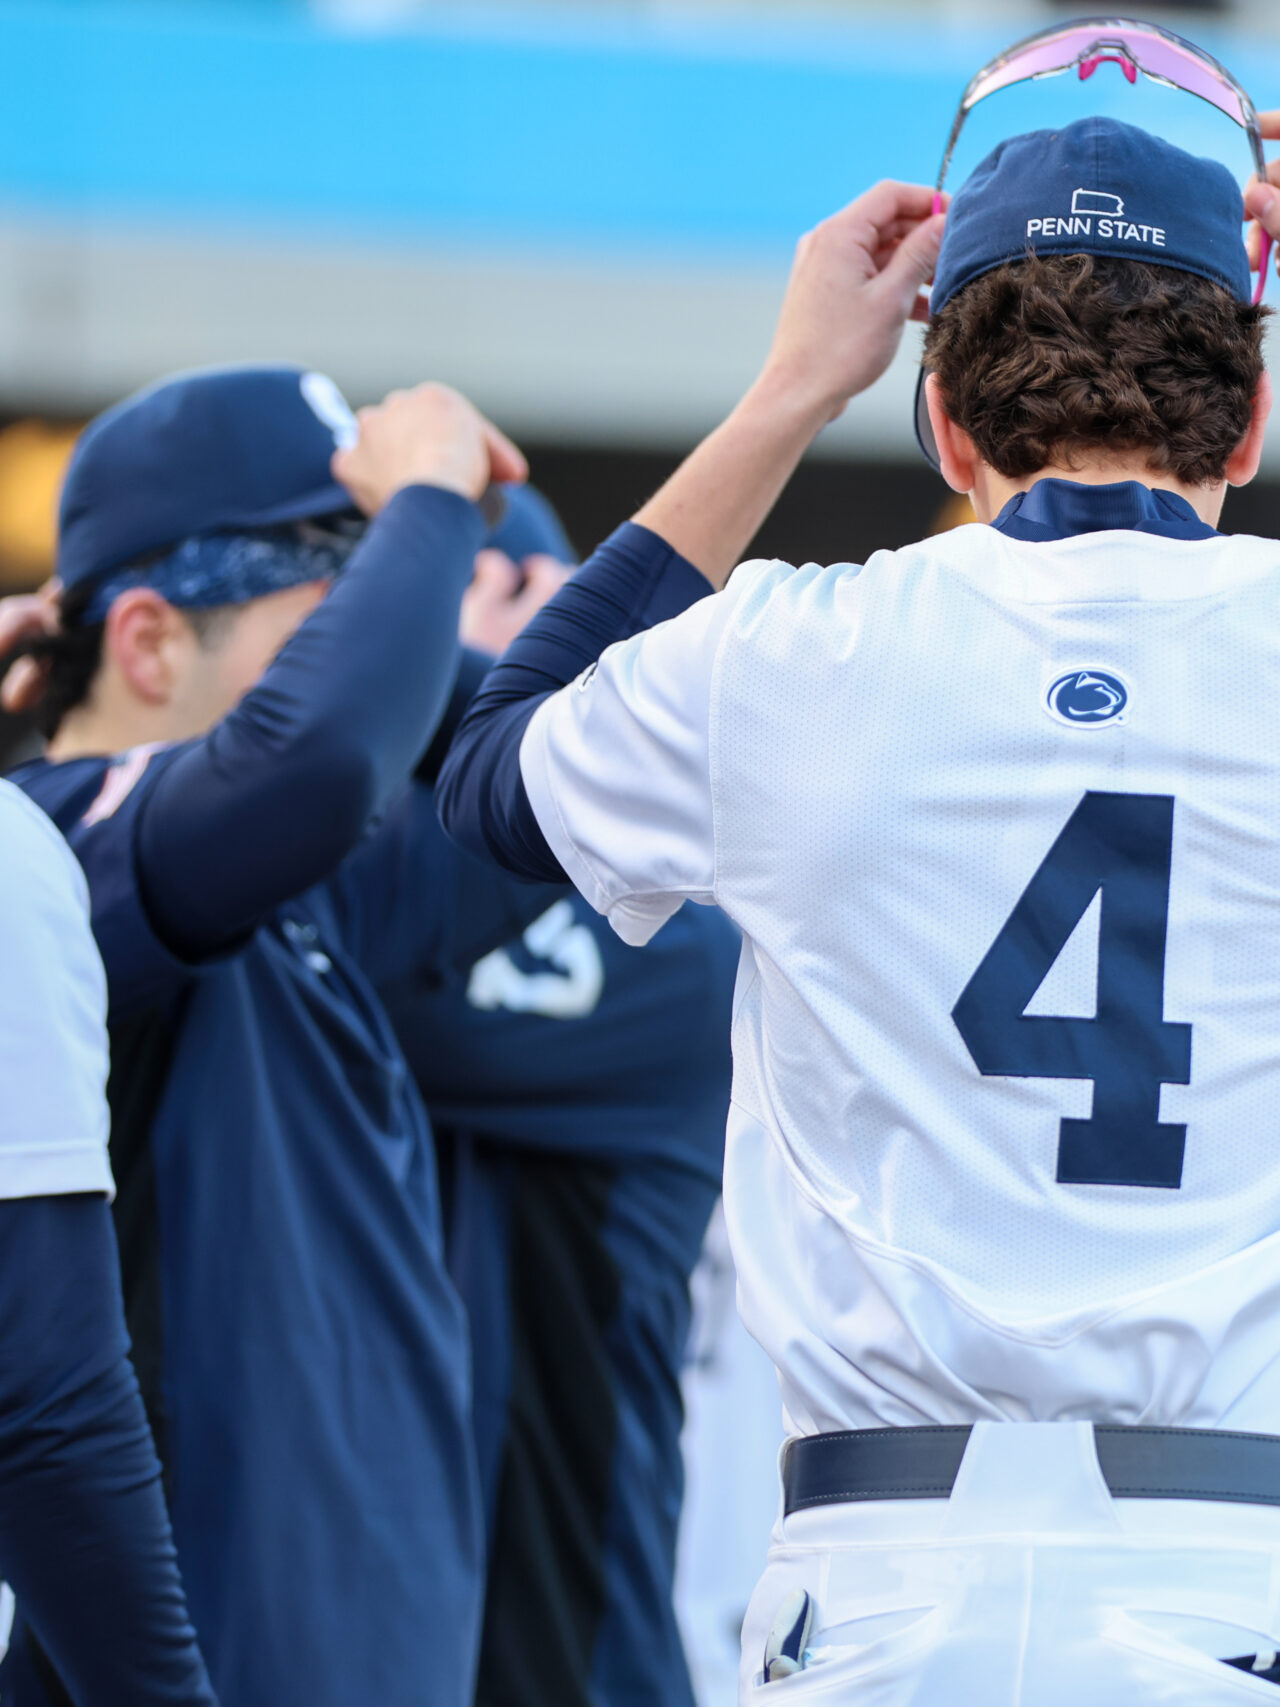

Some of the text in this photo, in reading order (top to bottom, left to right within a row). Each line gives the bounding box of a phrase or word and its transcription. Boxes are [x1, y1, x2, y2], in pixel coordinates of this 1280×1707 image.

[1026, 217, 1166, 247] PENN STATE
[951, 790, 1192, 1189] 4
